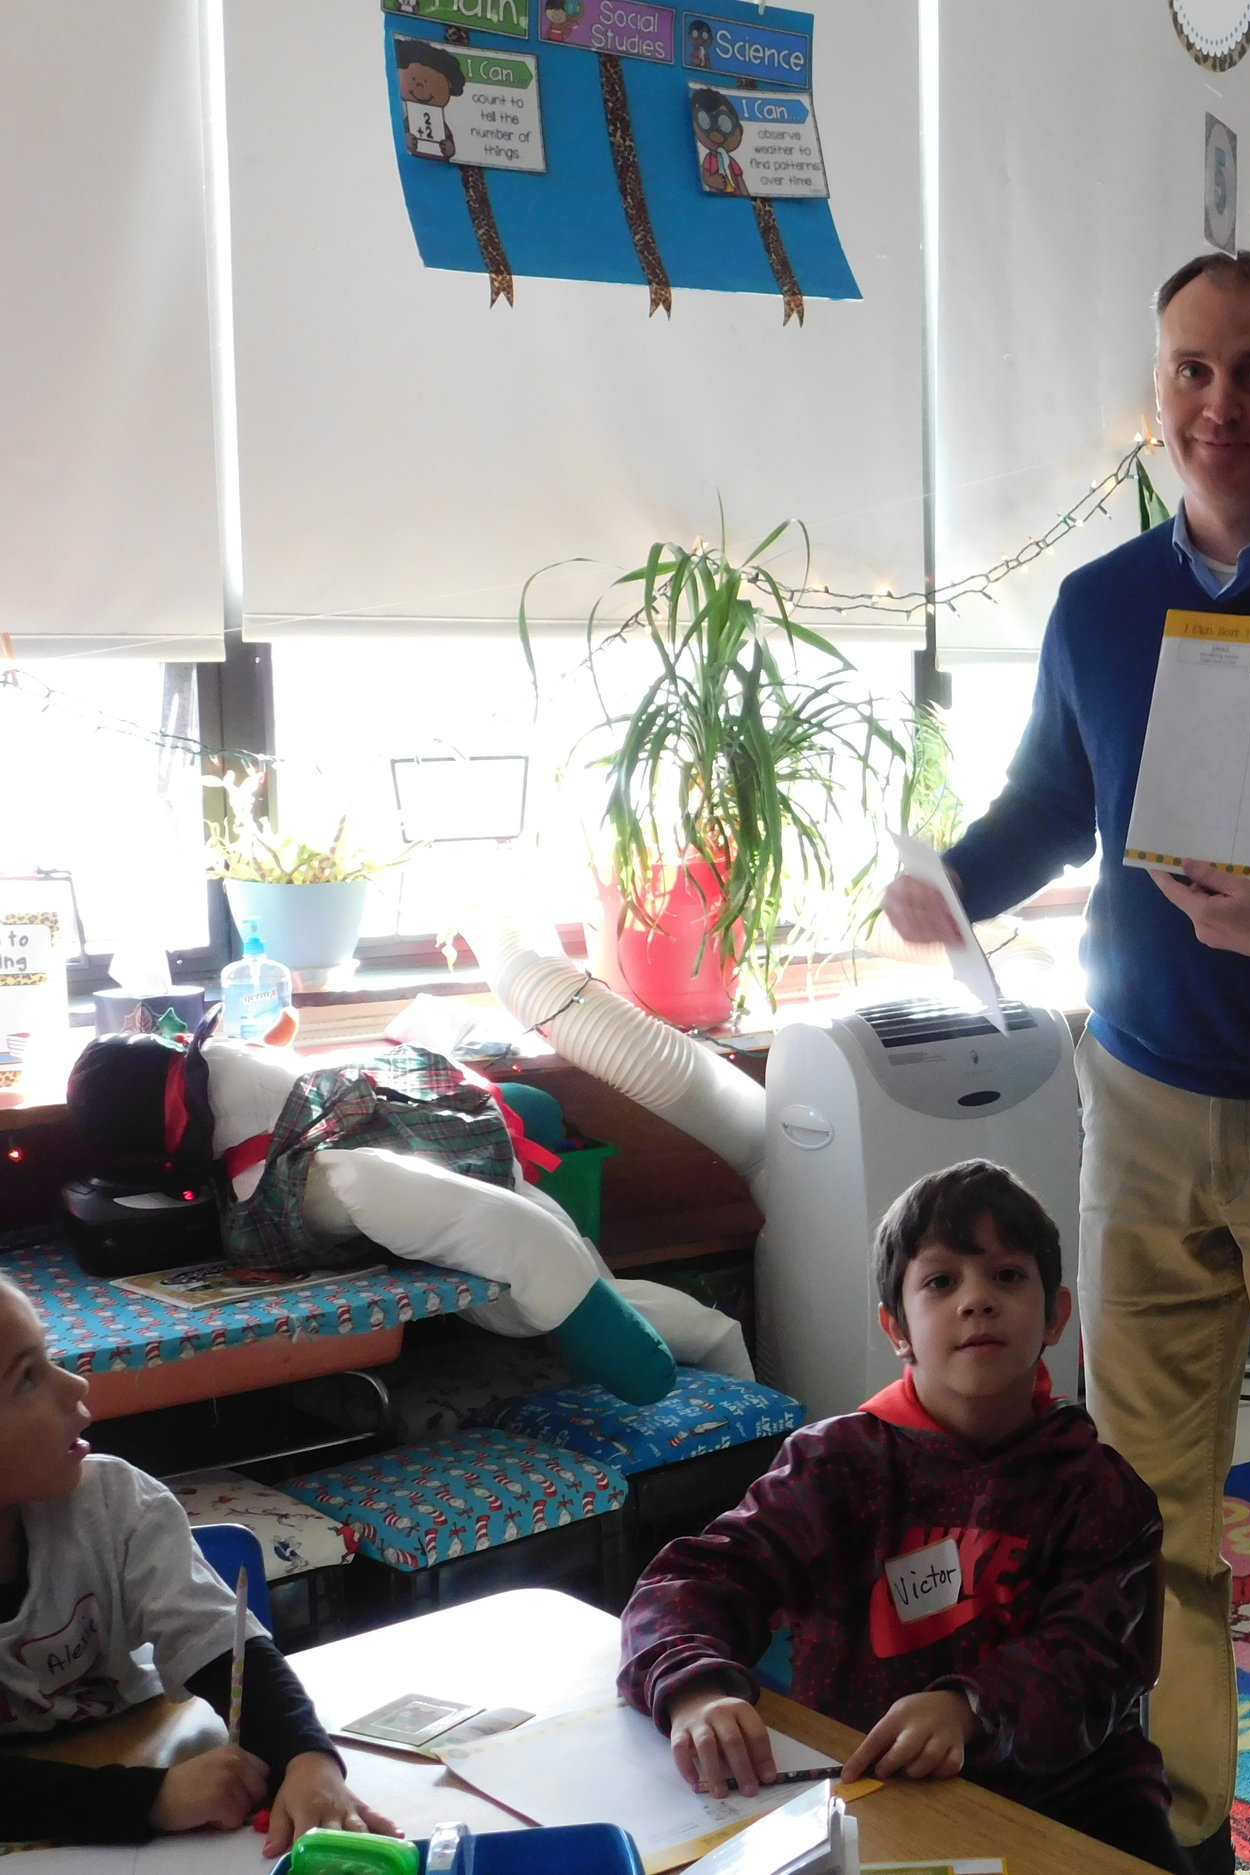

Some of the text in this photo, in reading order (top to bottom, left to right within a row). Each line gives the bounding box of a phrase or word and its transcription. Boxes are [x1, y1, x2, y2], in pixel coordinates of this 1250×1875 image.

[599, 2, 659, 33] Social
[591, 24, 666, 60] Studies
[715, 30, 805, 71] Science
[472, 94, 525, 109] count to
[423, 112, 431, 125] 2
[500, 111, 520, 125] the
[470, 127, 532, 142] number of
[757, 130, 801, 140] observe
[484, 146, 520, 161] things
[754, 145, 794, 156] weather
[773, 160, 820, 173] patterns
[760, 176, 784, 186] over
[8, 930, 29, 947] to
[894, 1565, 957, 1606] Victor
